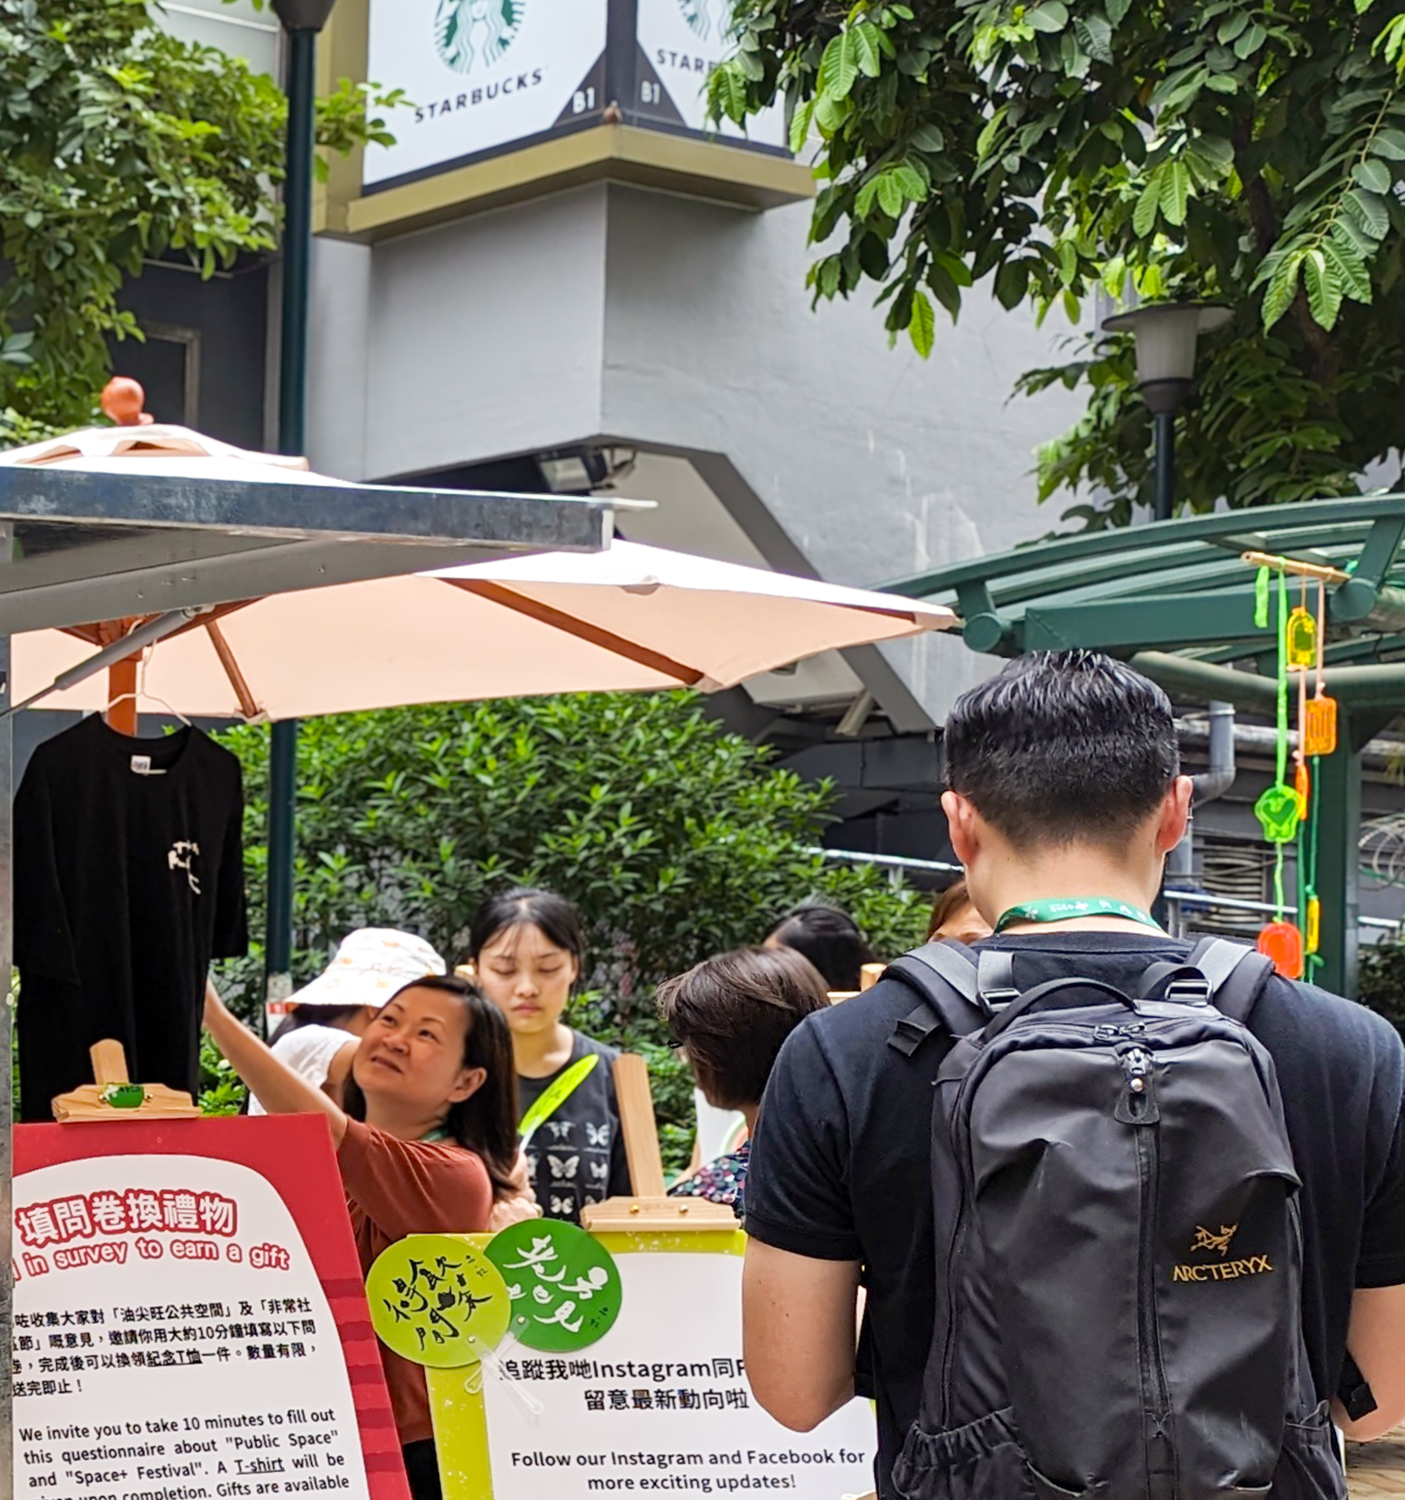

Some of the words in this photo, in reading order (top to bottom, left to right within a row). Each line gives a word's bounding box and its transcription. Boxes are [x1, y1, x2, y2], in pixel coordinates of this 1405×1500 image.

[415, 71, 543, 124] STARBUCKS
[572, 86, 595, 114] B1
[640, 80, 661, 105] B1
[18, 1190, 236, 1246] 填問卷換禮物
[25, 1252, 48, 1276] in
[55, 1241, 127, 1269] survey
[137, 1239, 162, 1258] to
[171, 1238, 217, 1260] earn
[227, 1244, 242, 1262] a
[250, 1243, 289, 1270] gift
[584, 1389, 749, 1411] 留意最新動向啦
[19, 1428, 43, 1442] We
[47, 1424, 90, 1440] invite
[94, 1425, 121, 1439] you
[126, 1422, 141, 1435] to
[146, 1419, 178, 1434] take
[184, 1417, 200, 1431] 10
[205, 1413, 264, 1430] minutes
[268, 1413, 283, 1426] to
[287, 1410, 306, 1424] fill
[310, 1408, 335, 1422] out
[24, 1449, 52, 1465] this
[62, 1443, 165, 1464] questionnaire
[174, 1439, 217, 1455] about
[225, 1433, 280, 1451] "Public
[288, 1430, 338, 1448] Space"
[512, 1452, 570, 1467] Follow
[576, 1453, 606, 1466] our
[612, 1451, 703, 1469] Instagram
[709, 1451, 741, 1465] and
[747, 1449, 834, 1465] Facebook
[839, 1449, 865, 1464] for
[29, 1473, 56, 1487] and
[66, 1470, 128, 1487] "Space+
[137, 1462, 209, 1480] Festival".
[217, 1461, 227, 1474] A
[236, 1457, 284, 1475] T-shirt
[292, 1453, 319, 1469] will
[327, 1453, 345, 1466] be
[588, 1476, 635, 1490] more
[640, 1475, 712, 1493] exciting
[716, 1474, 795, 1492] updates!
[217, 1482, 251, 1497] Gifts
[255, 1480, 279, 1494] are
[284, 1476, 349, 1493] available
